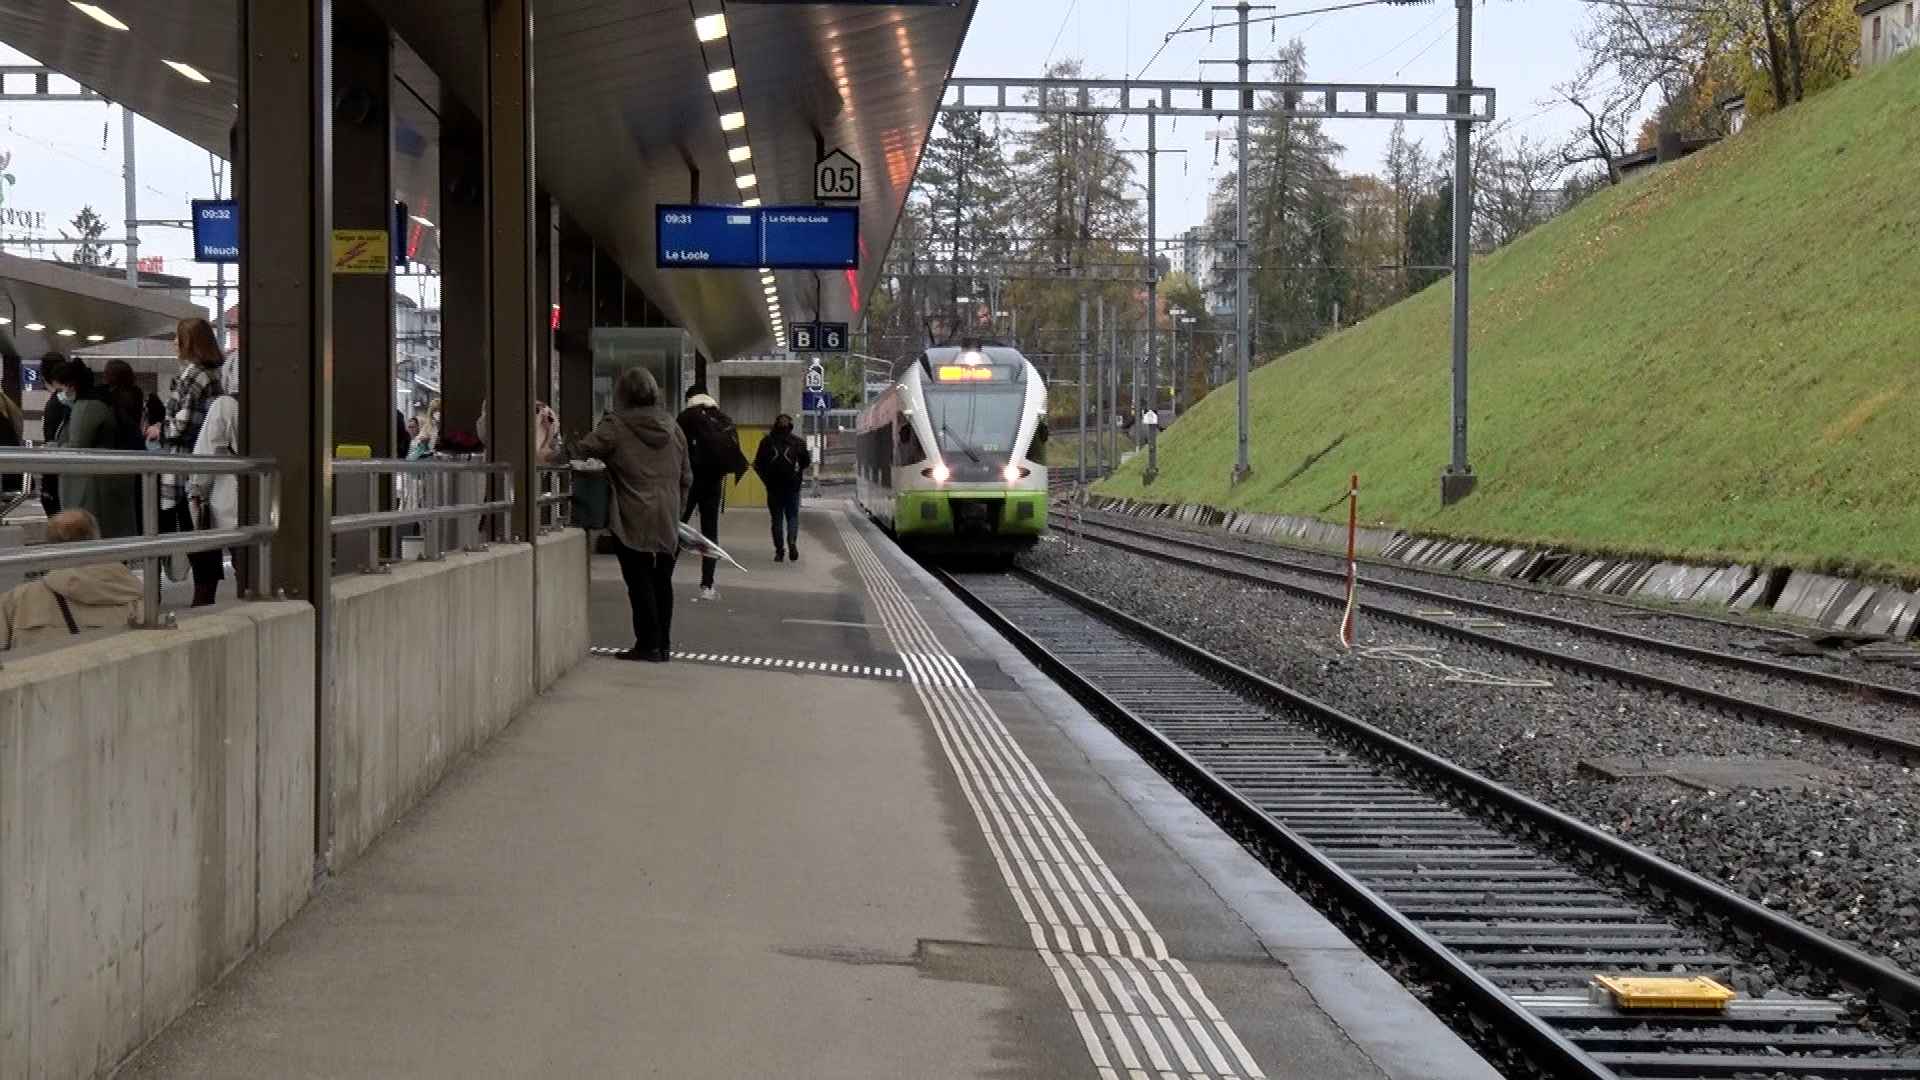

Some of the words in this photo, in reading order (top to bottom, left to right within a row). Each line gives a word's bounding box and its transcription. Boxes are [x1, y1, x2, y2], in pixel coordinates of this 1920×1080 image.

[820, 167, 854, 193] 0.5
[202, 209, 231, 219] 09:32
[665, 214, 692, 224] 09:31
[665, 250, 679, 260] Le
[681, 250, 709, 260] Locle
[797, 331, 811, 347] B
[827, 331, 840, 347] 6
